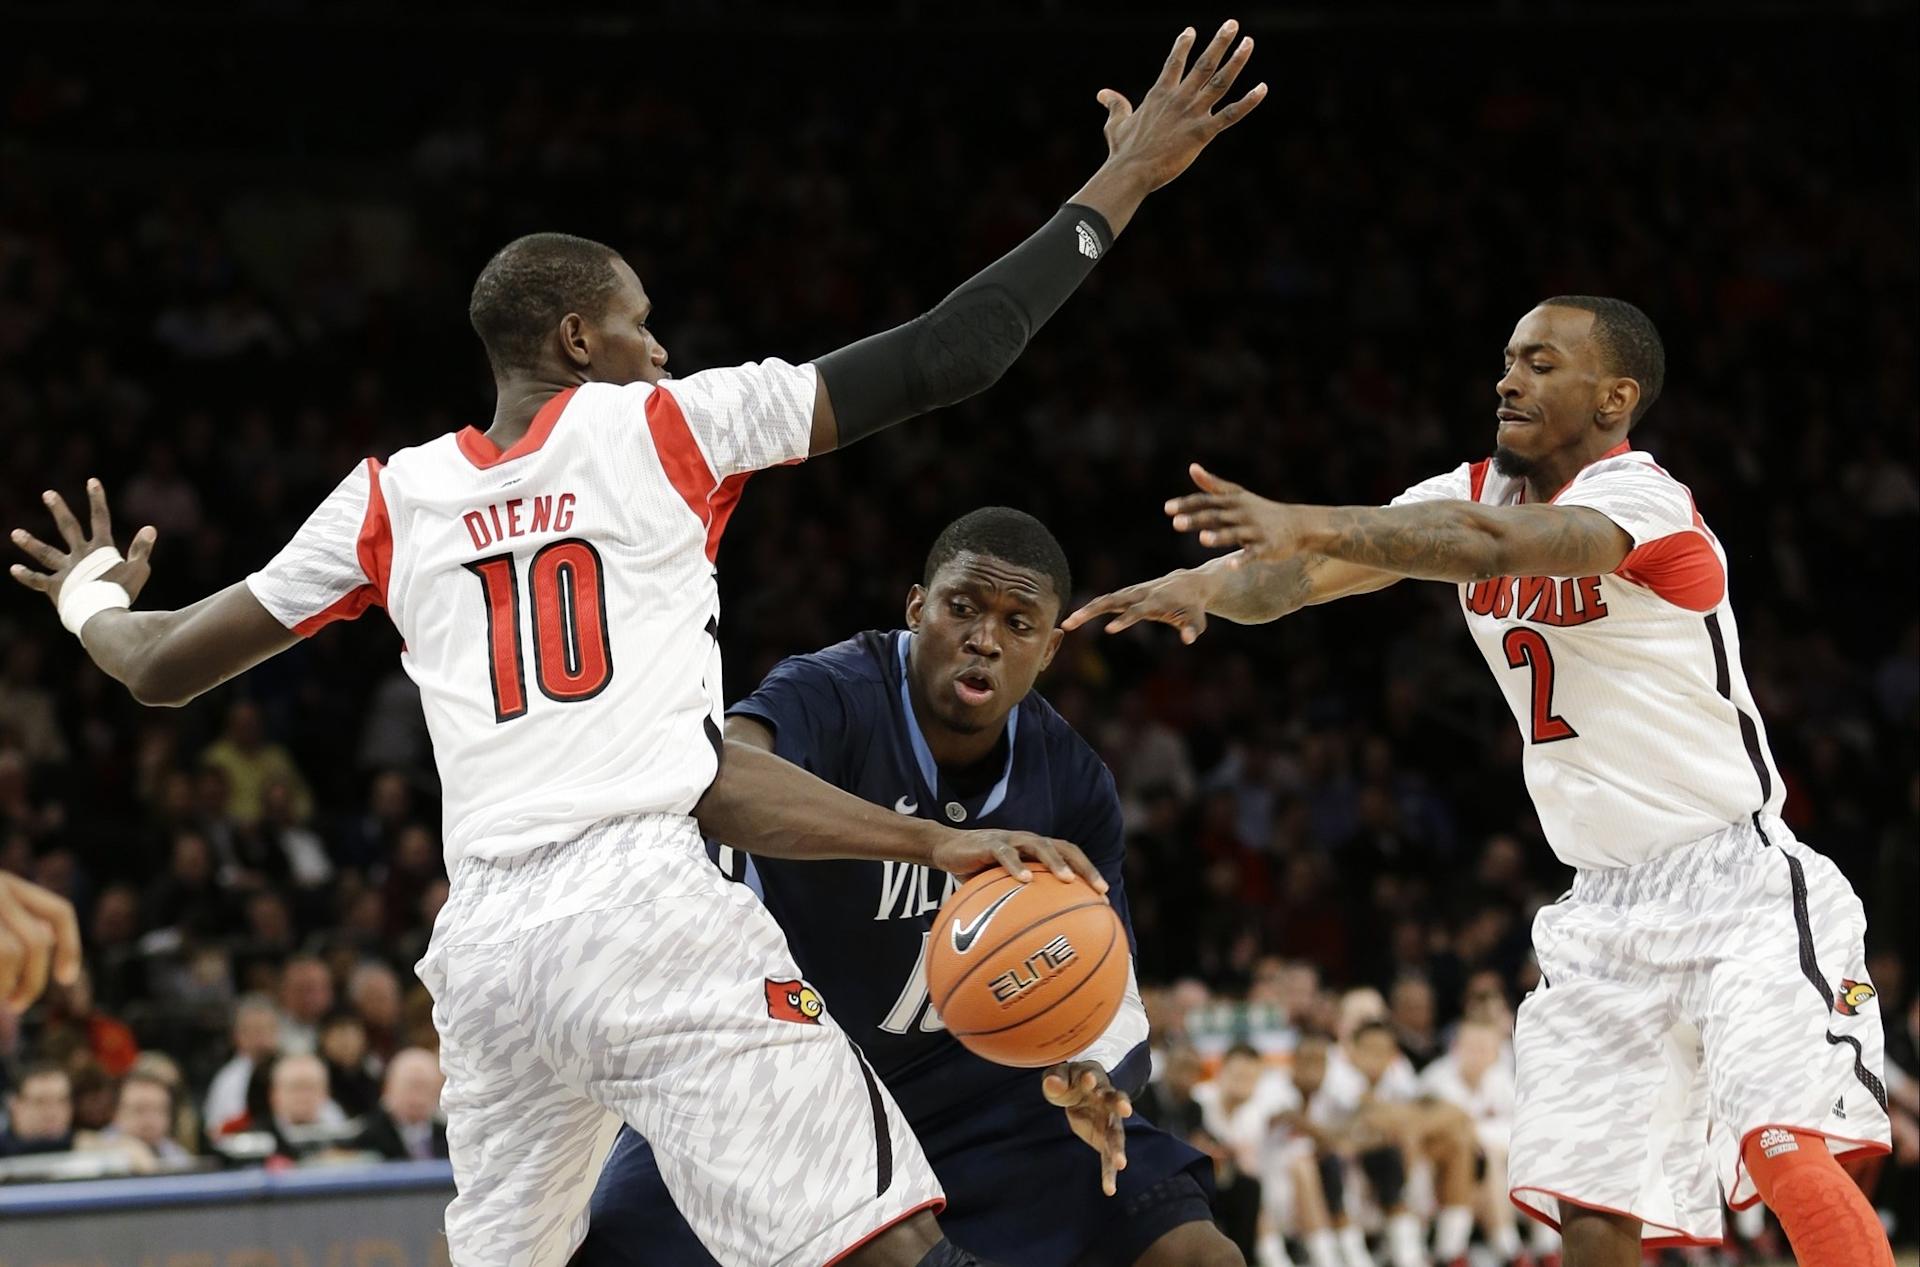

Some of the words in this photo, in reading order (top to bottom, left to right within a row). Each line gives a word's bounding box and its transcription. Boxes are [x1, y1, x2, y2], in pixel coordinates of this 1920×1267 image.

[463, 493, 576, 551] DIENG
[461, 537, 614, 724] 10
[1503, 626, 1580, 745] 2
[988, 934, 1077, 1004] ELITE
